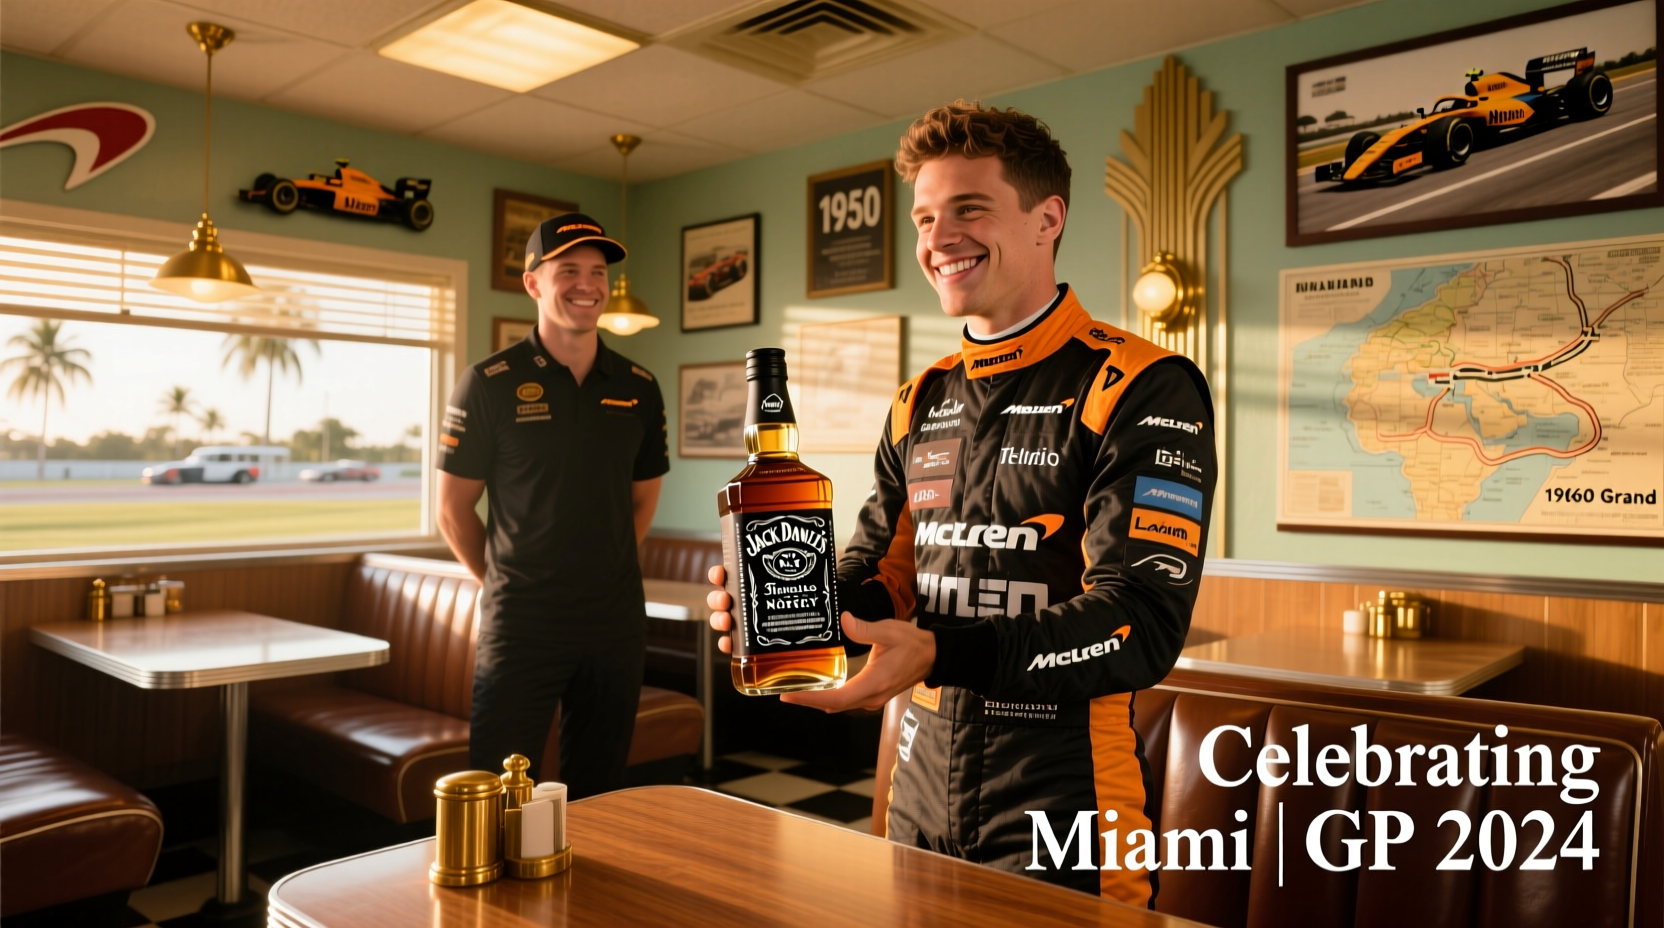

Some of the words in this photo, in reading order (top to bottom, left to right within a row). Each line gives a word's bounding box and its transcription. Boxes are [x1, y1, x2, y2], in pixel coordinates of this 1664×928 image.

[819, 186, 881, 234] 1950
[1600, 488, 1657, 505] Grand
[745, 525, 782, 557] JACK
